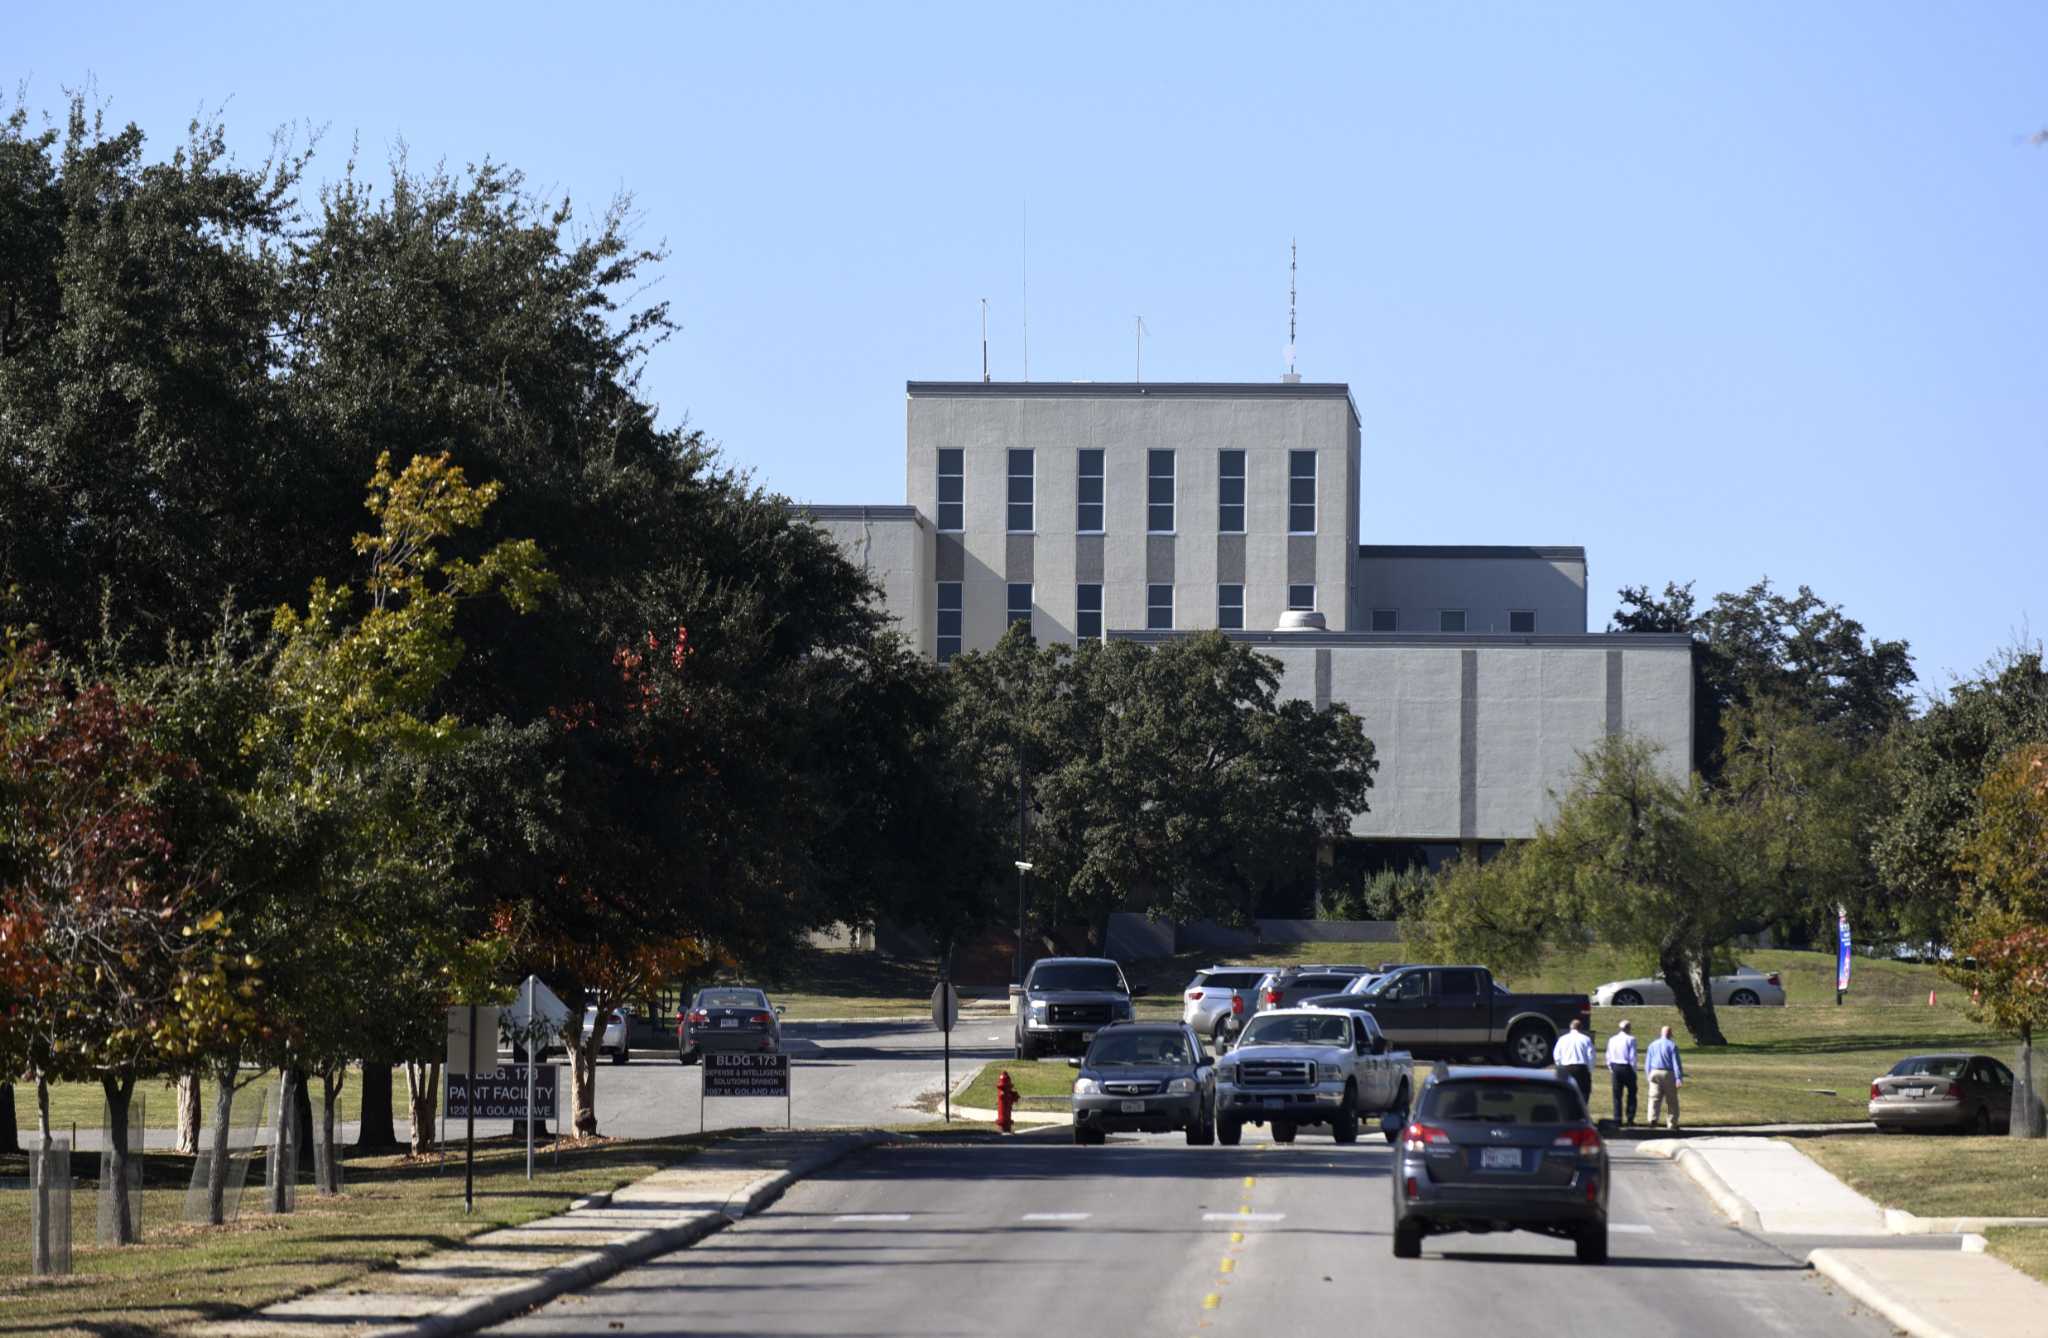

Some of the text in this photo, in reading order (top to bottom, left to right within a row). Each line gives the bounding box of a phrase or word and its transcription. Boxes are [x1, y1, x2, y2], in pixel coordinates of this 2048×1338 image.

[716, 1056, 777, 1066] BLDG. 173
[465, 1067, 510, 1081] LDG.
[449, 1086, 553, 1100] PANT FACILTY
[486, 1105, 530, 1116] GOLAND
